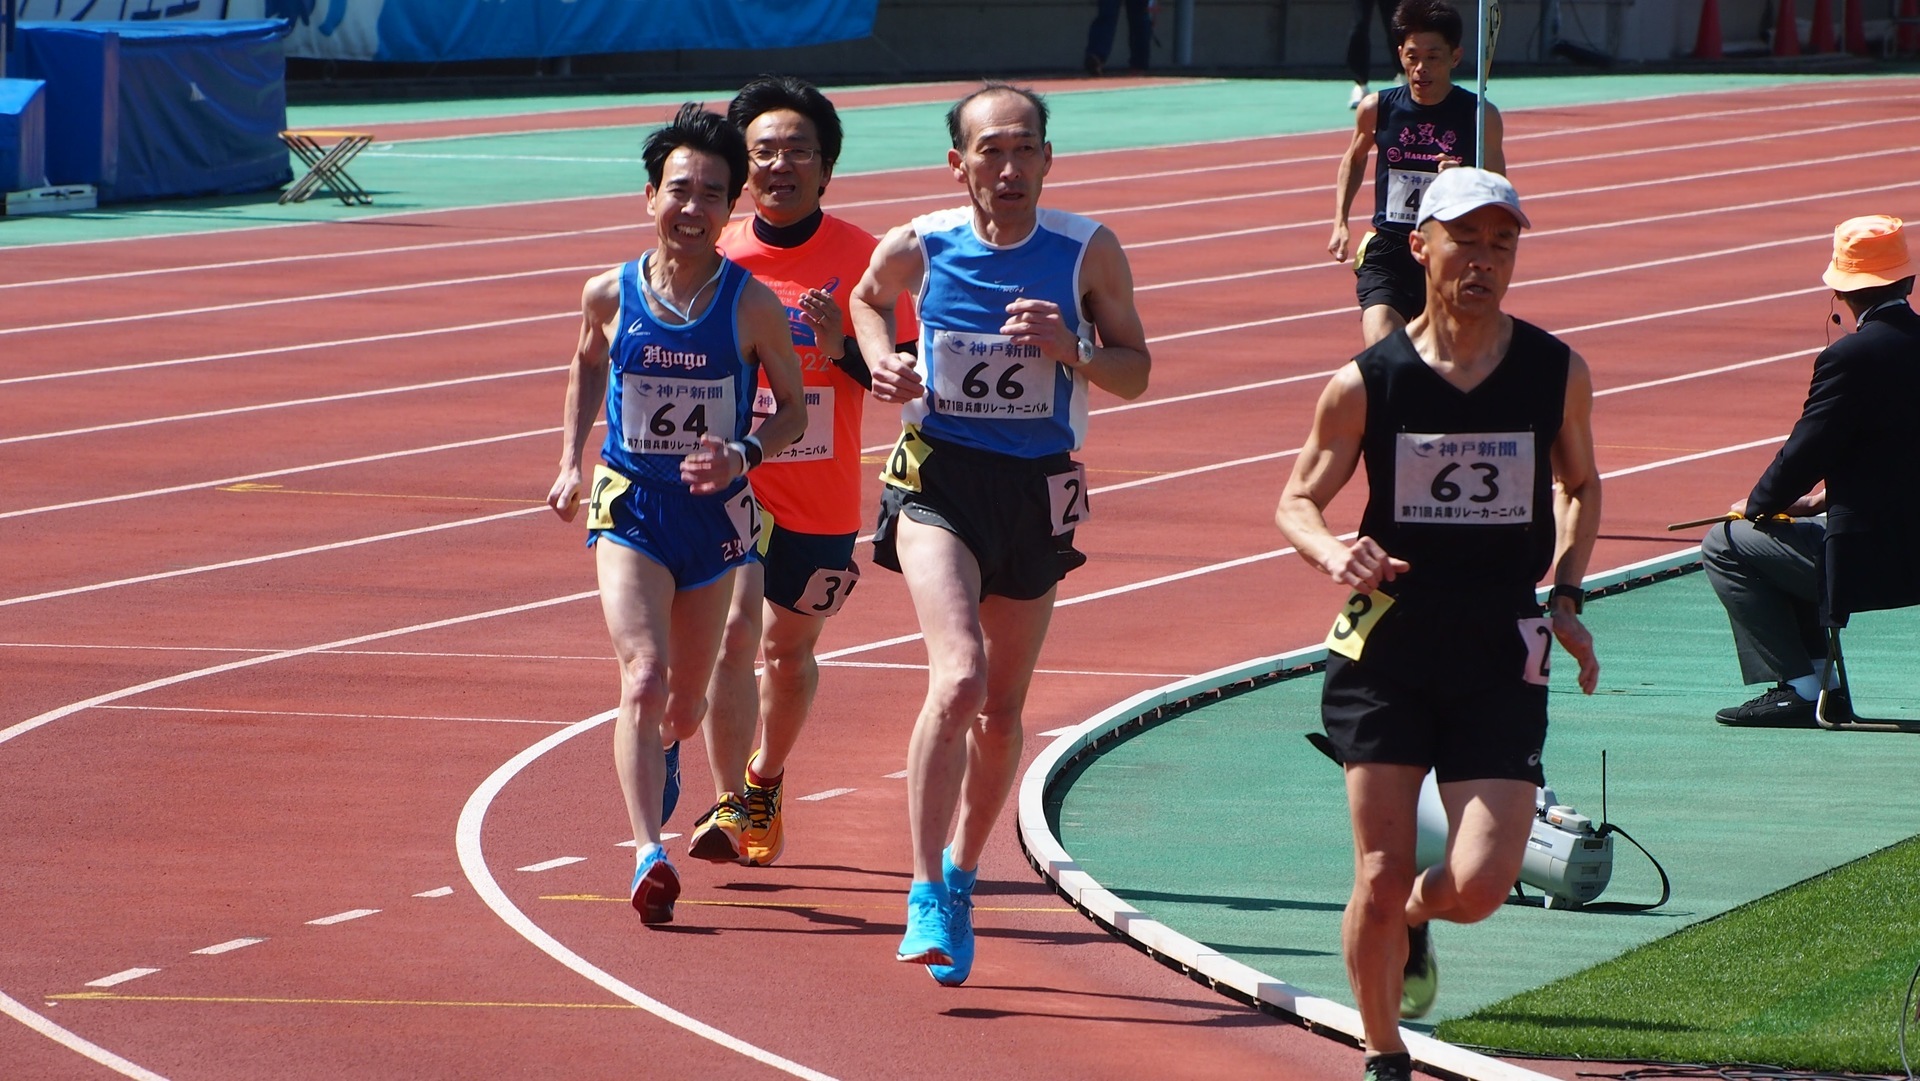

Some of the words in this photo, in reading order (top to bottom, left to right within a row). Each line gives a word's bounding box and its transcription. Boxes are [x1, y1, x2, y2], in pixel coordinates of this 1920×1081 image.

[643, 345, 707, 370] Hyogo
[969, 341, 1041, 358] 神戸新聞
[962, 361, 1025, 399] 66
[656, 384, 723, 399] 神戸新聞
[938, 398, 1049, 414] 第71回兵庫リレーカーニバル
[650, 402, 708, 438] 64
[1438, 440, 1517, 457] 神戸新聞
[1430, 462, 1499, 503] 63
[1402, 505, 1527, 519] 第71回兵庫リレーカーニバル
[1333, 592, 1373, 640] 3
